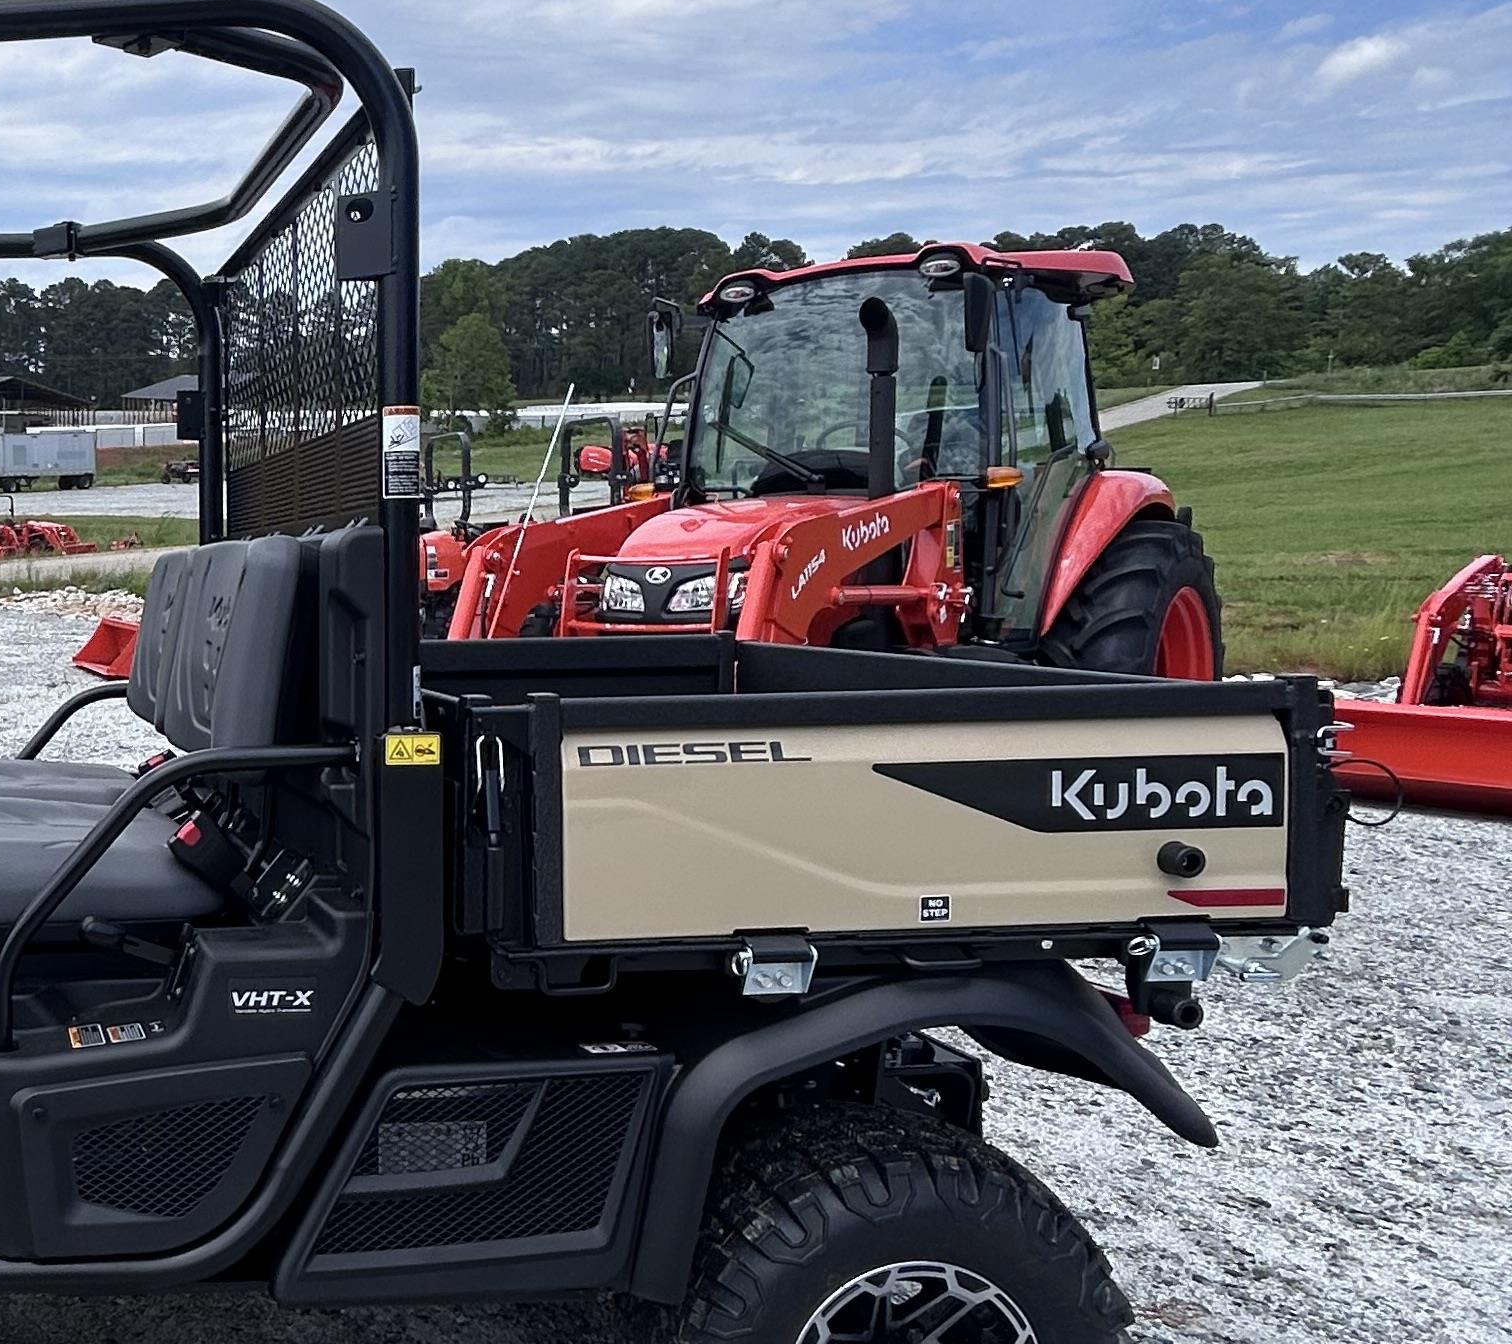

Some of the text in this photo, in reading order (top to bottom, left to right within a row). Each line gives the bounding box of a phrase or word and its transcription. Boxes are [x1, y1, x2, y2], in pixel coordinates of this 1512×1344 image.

[840, 511, 890, 551] Kubota
[577, 741, 813, 767] DIESEL
[1051, 765, 1274, 820] Kubota
[923, 908, 948, 917] STEP
[928, 899, 943, 907] NO
[231, 990, 315, 1007] VHT-X
